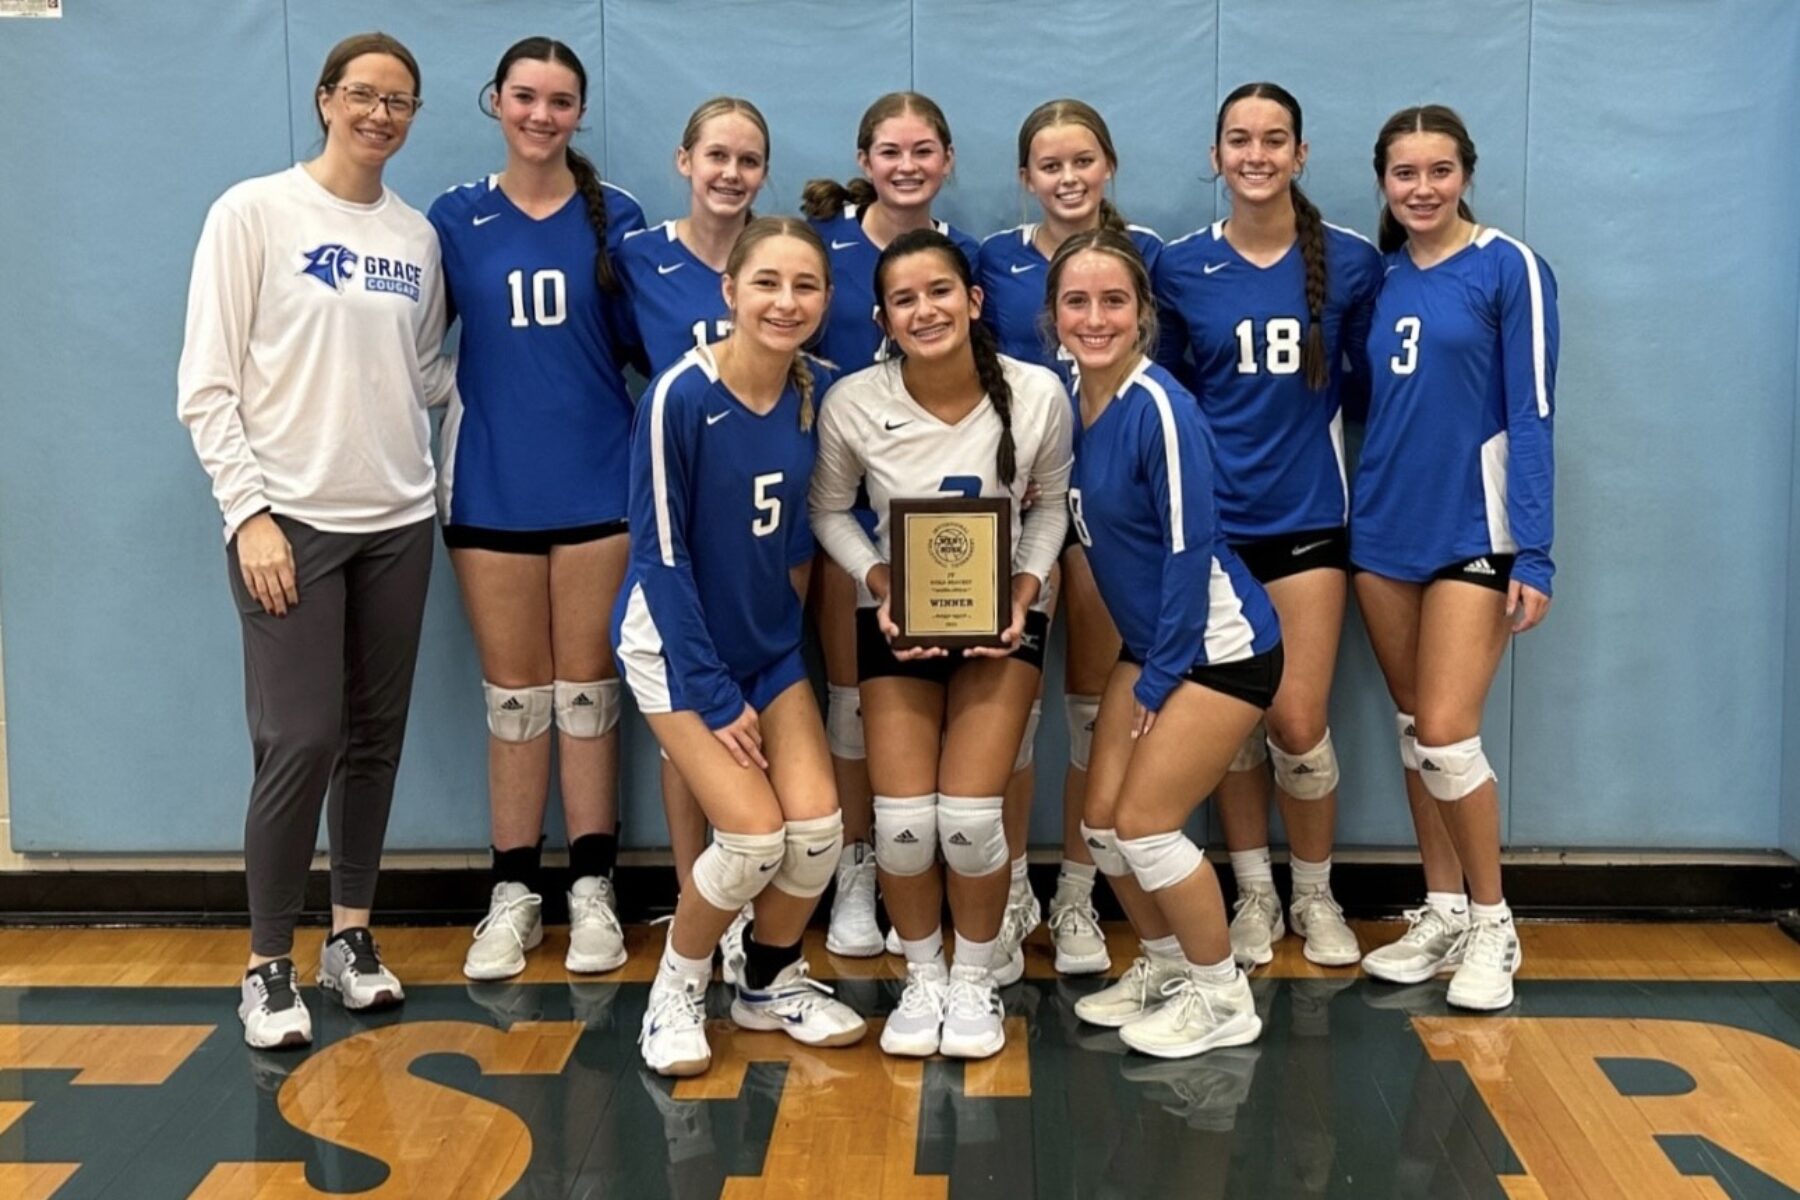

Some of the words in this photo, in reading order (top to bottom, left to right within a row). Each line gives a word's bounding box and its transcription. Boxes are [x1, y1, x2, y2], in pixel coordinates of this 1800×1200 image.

[365, 256, 422, 287] GRACE
[507, 269, 567, 328] 10
[1236, 318, 1301, 374] 18
[1391, 316, 1421, 375] 3
[752, 472, 784, 537] 5
[930, 599, 974, 607] WINNER
